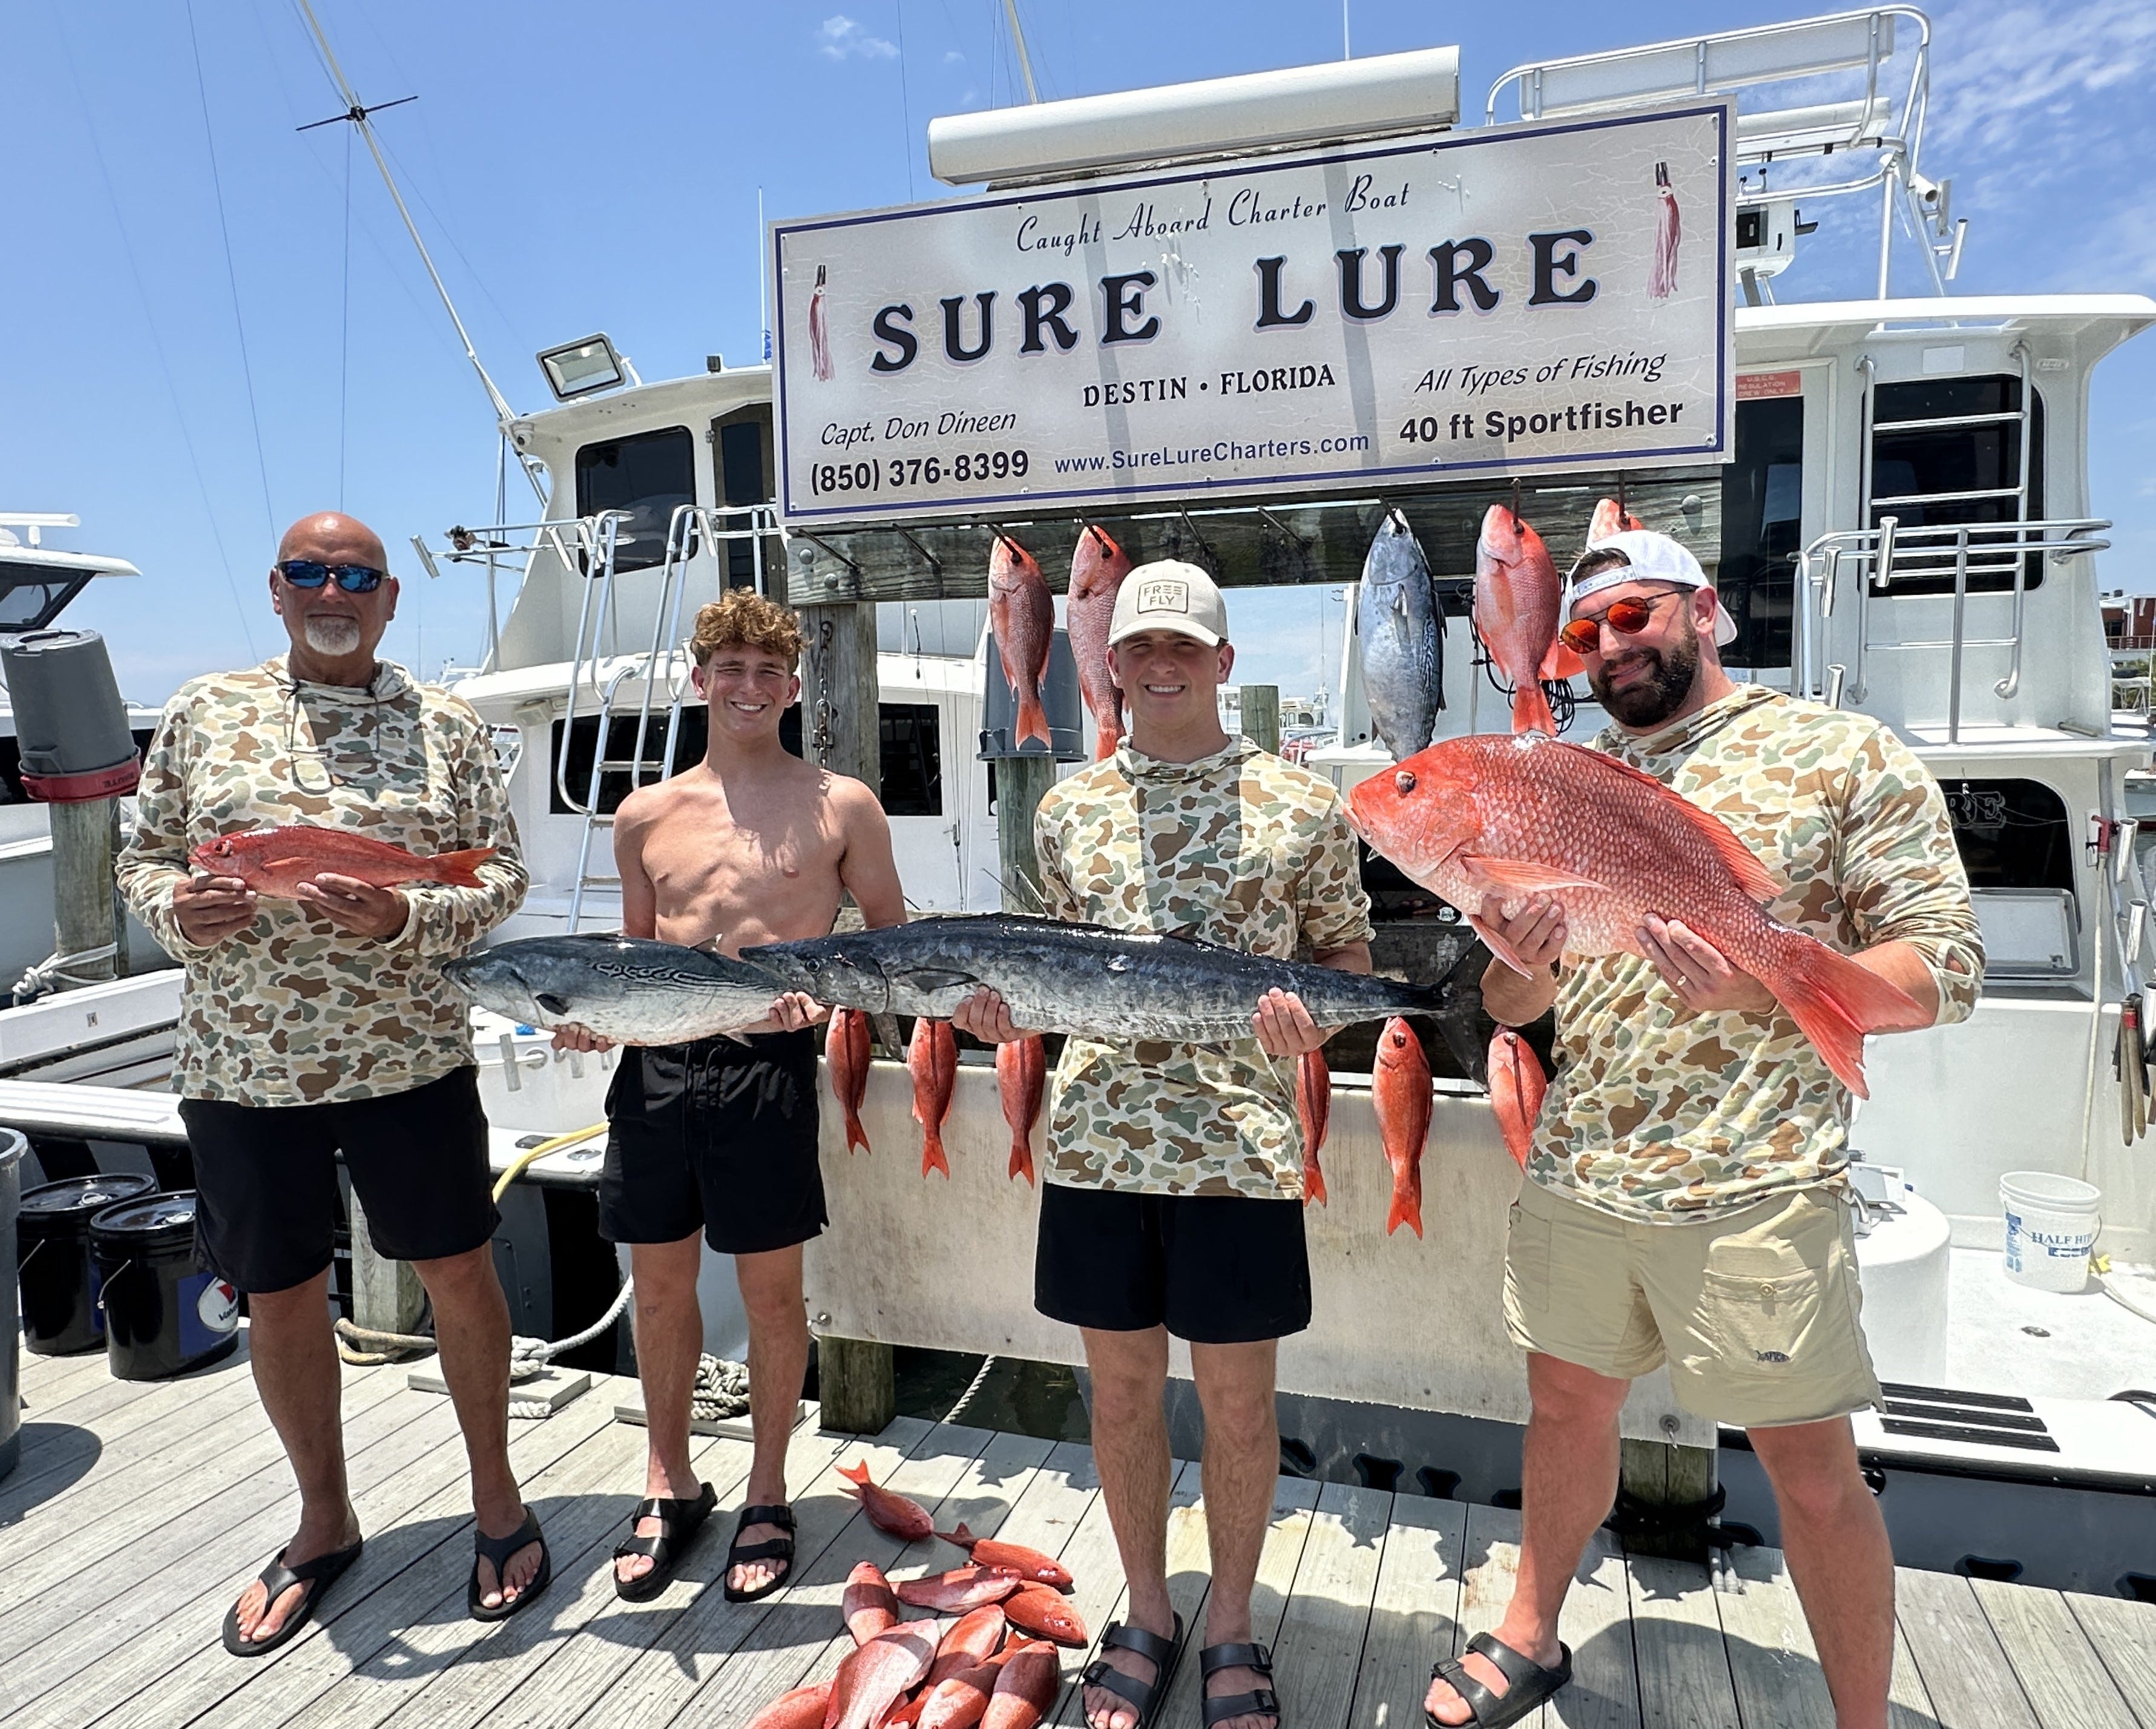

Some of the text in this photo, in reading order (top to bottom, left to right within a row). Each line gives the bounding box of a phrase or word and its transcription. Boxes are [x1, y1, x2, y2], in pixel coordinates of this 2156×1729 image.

[1017, 174, 1409, 256] Caught Aboard Charter Boat
[869, 227, 1600, 376] SURE LURE
[1083, 363, 1336, 407] DESTIN FLORIDA
[1414, 351, 1668, 396] All Types of Fishing
[821, 410, 1017, 451] Capt. Don Dineen
[1399, 400, 1683, 443] 40 ft Sportfisher
[810, 449, 1030, 496] (850) 376-8399
[1054, 434, 1370, 473] www.SureLureCharters.com
[1143, 585, 1182, 597] FREE
[1149, 596, 1175, 606] FLY
[2031, 1231, 2072, 1245] HALF
